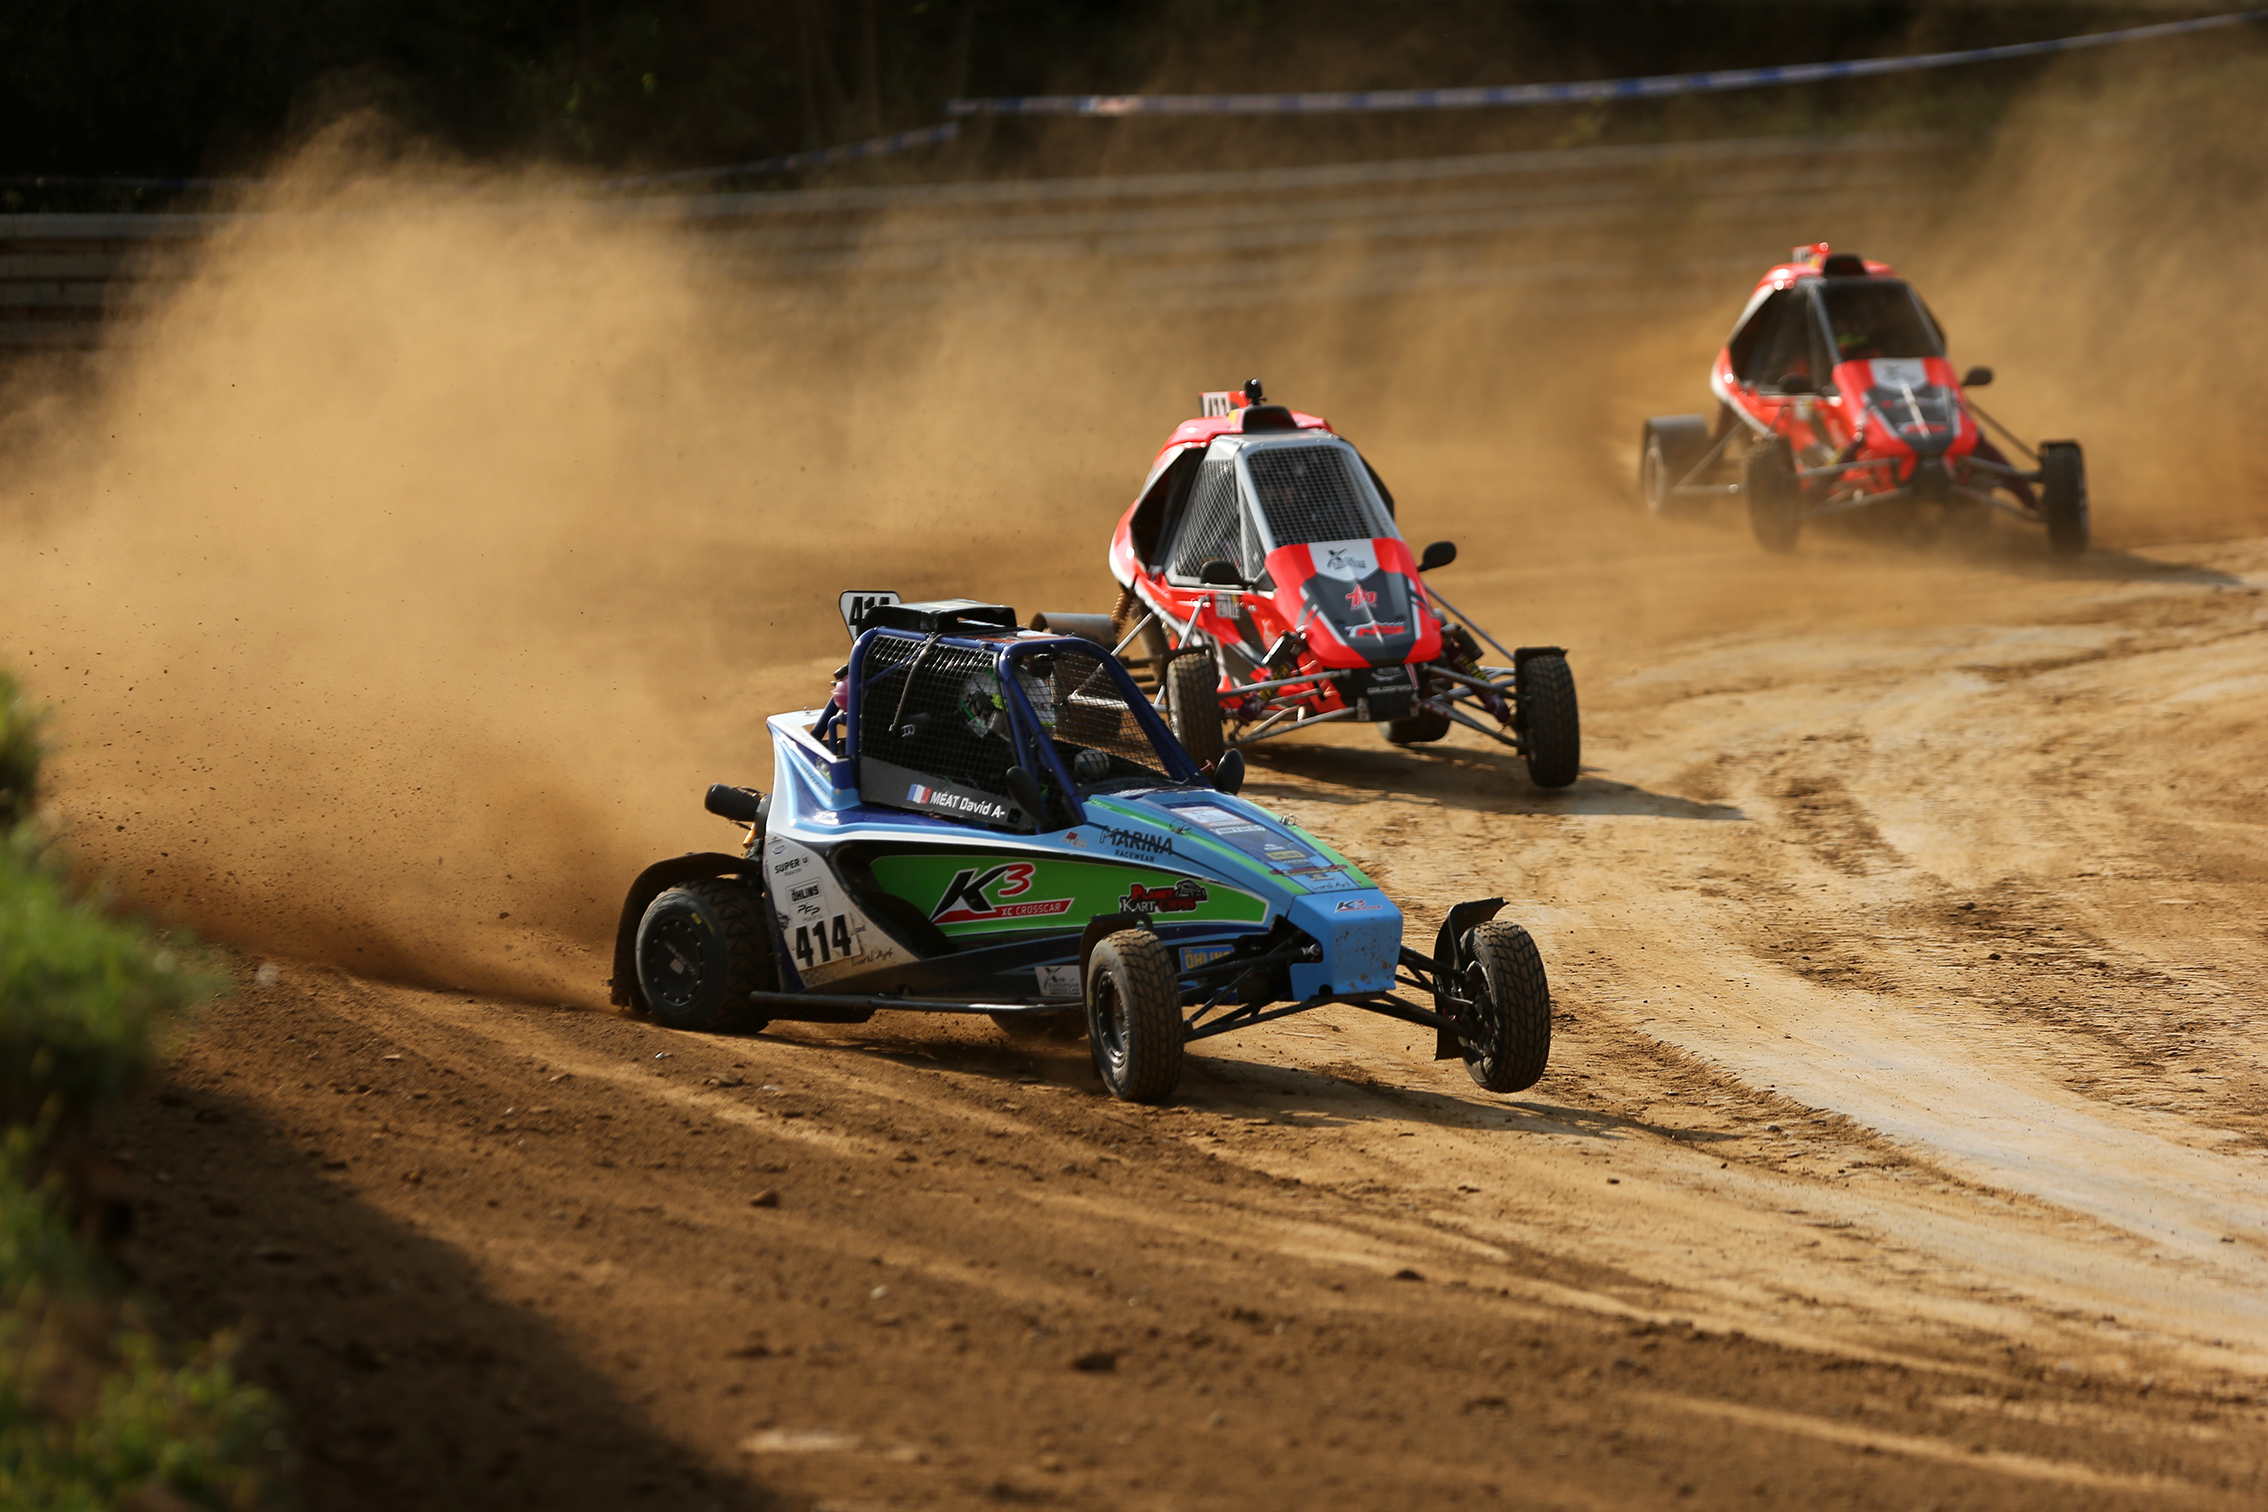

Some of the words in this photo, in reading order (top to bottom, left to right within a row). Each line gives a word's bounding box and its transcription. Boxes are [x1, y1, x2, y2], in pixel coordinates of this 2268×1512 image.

[930, 791, 960, 808] MÉAT
[959, 797, 992, 816] David
[1114, 849, 1155, 863] RACEWEAR
[774, 858, 801, 874] SUPER
[790, 885, 819, 902] ÖHLINS
[929, 862, 1035, 922] K3
[1001, 908, 1013, 917] XC
[1015, 902, 1061, 916] CROSSCAR
[795, 914, 851, 968] 414
